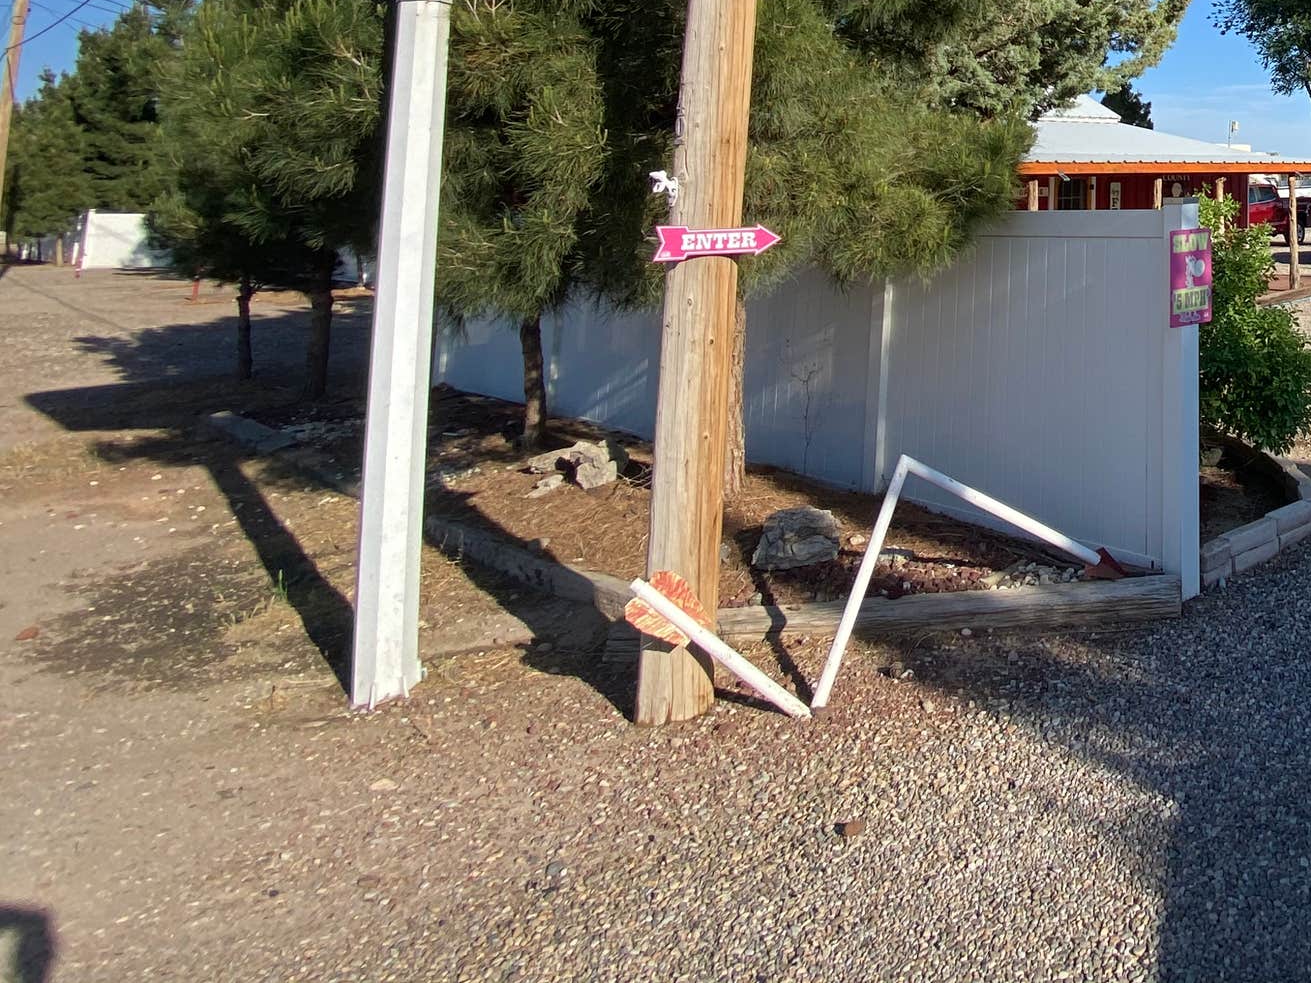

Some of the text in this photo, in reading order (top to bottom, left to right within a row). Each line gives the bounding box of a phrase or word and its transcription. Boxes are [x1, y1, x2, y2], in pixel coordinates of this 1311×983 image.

[681, 232, 757, 251] ENTER
[1173, 232, 1209, 254] SLOW
[1175, 288, 1206, 310] 5 MPH
